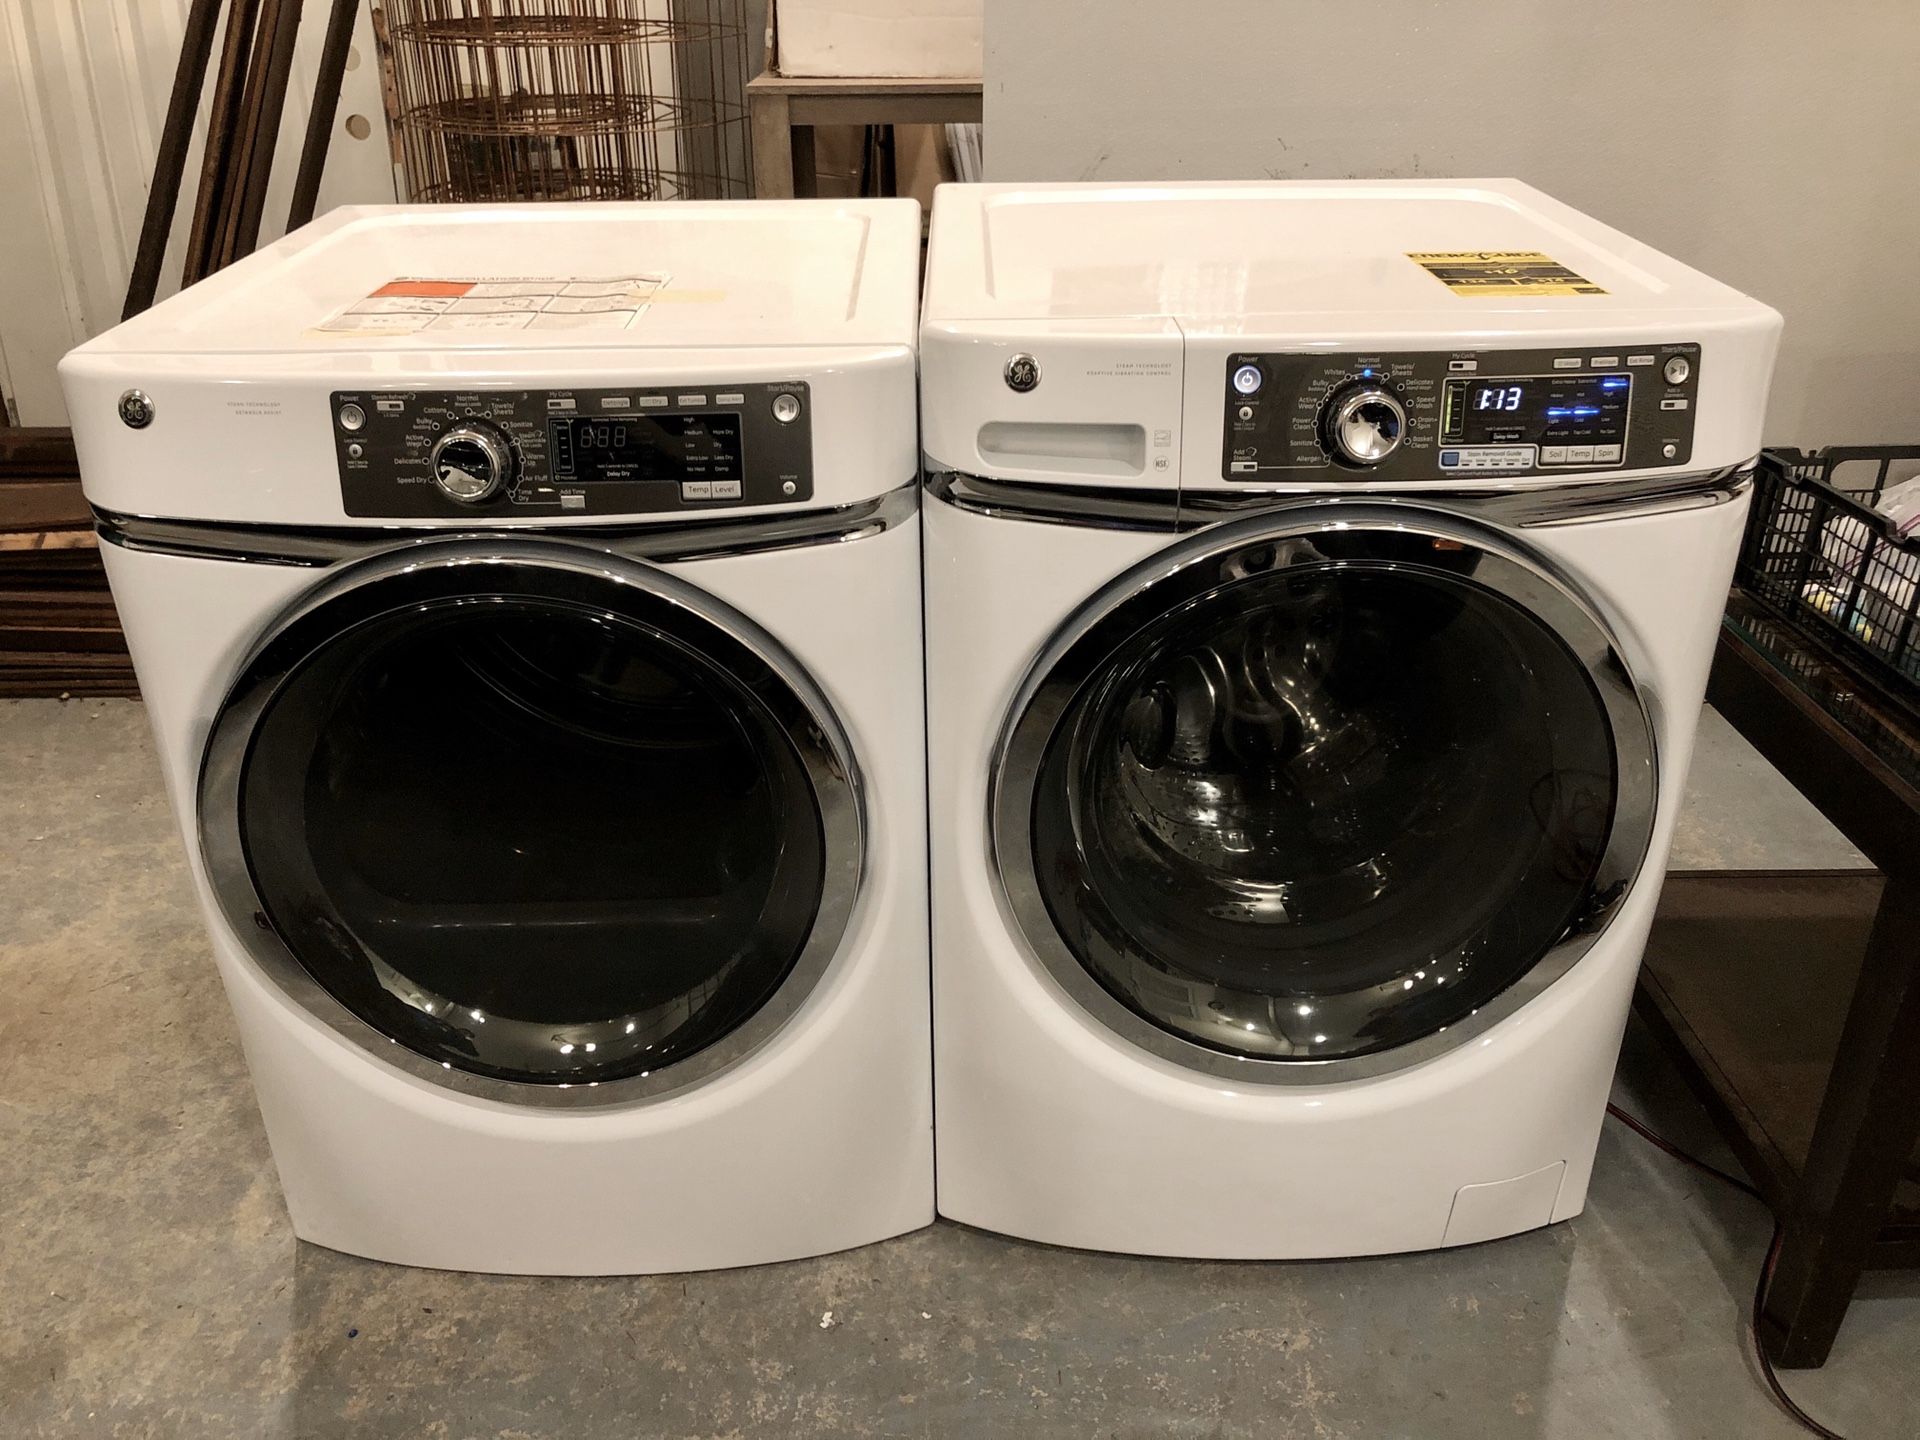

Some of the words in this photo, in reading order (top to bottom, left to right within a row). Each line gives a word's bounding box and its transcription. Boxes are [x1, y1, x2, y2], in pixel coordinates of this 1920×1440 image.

[1571, 449, 1591, 458] Temp
[1598, 448, 1613, 457] Spin
[688, 486, 709, 494] Temp
[715, 485, 735, 493] Level
